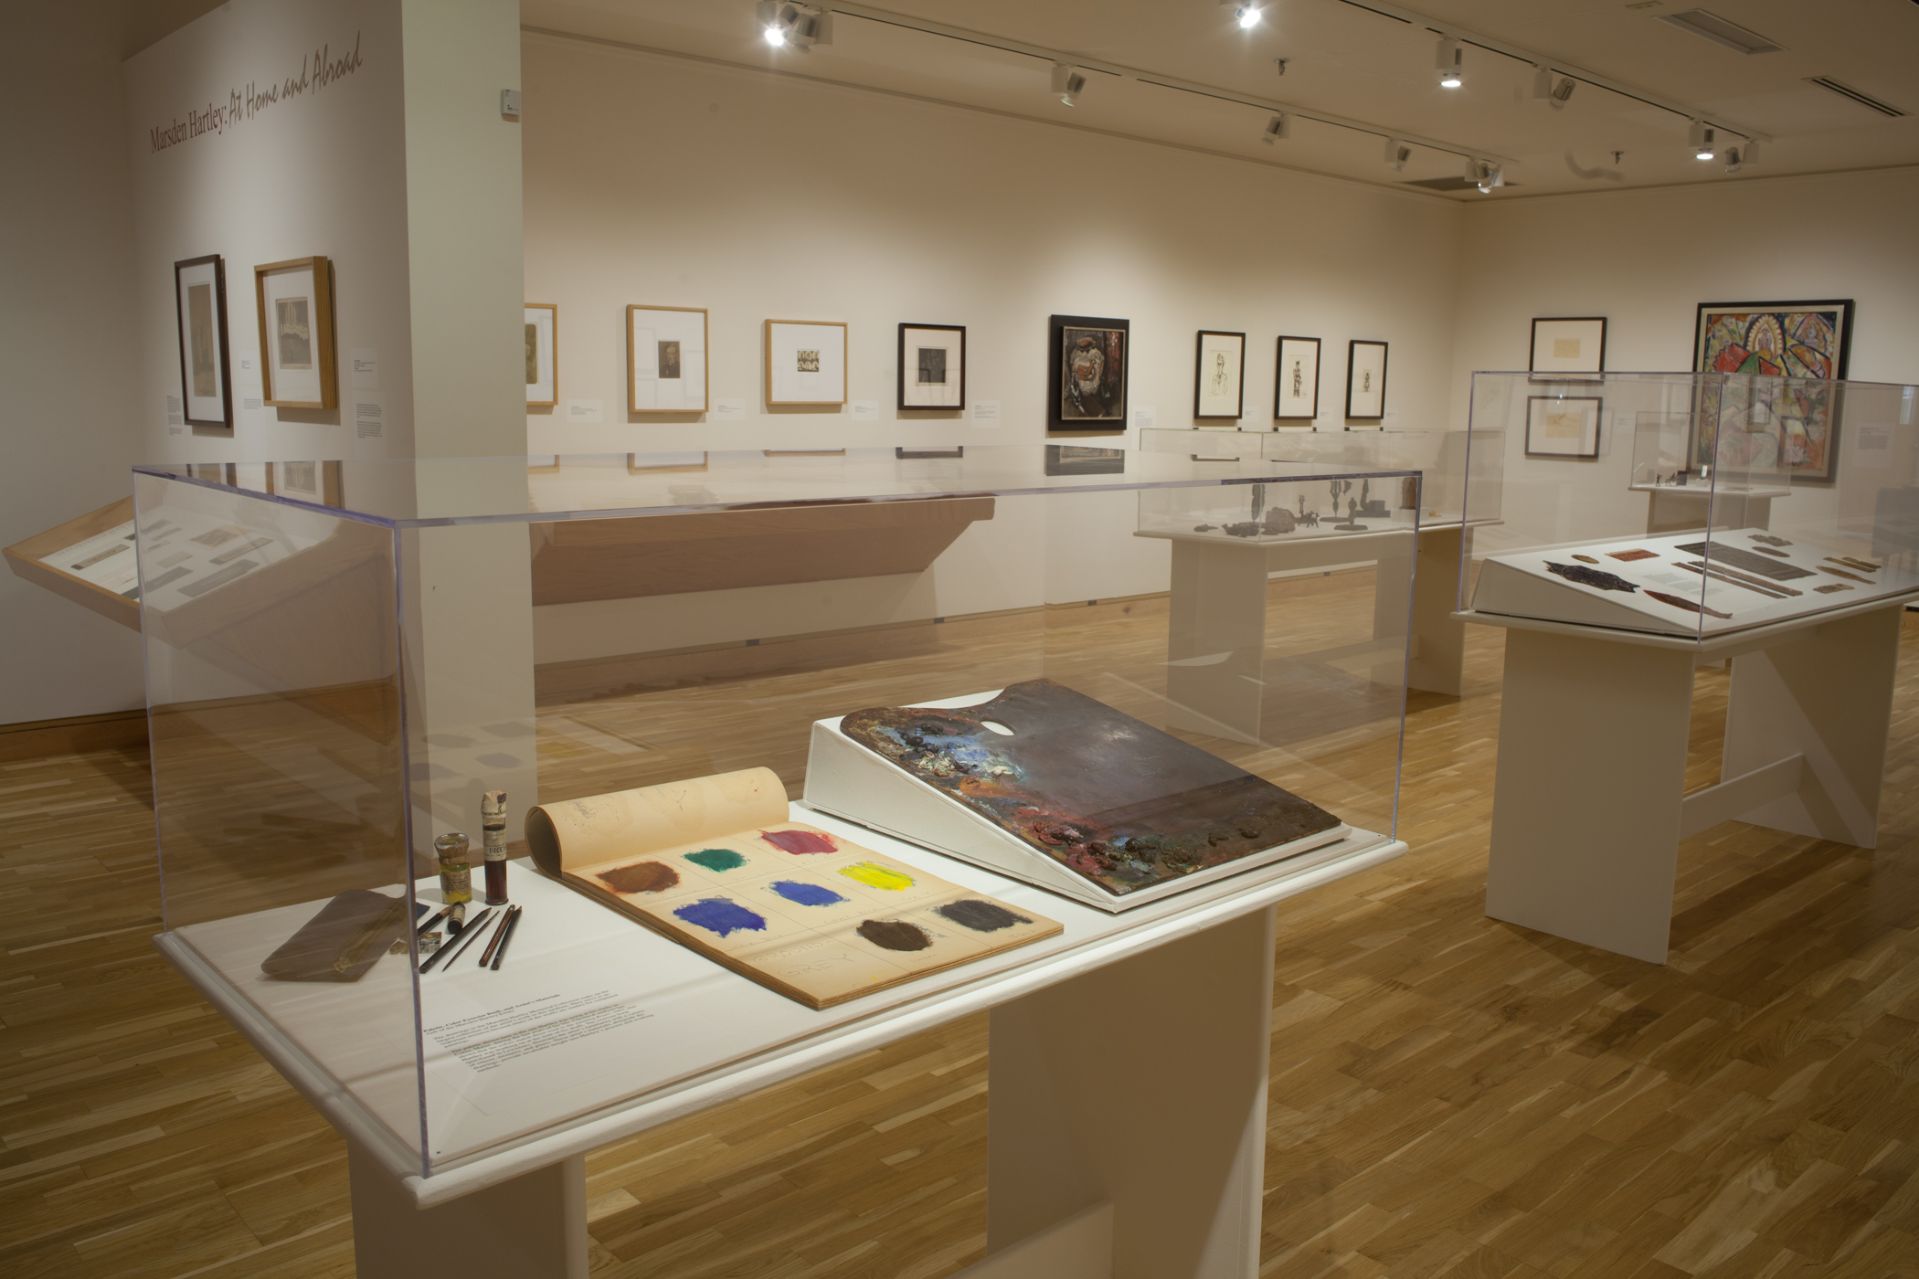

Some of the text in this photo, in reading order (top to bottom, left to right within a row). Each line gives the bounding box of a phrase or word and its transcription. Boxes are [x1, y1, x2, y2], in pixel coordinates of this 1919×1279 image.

[150, 29, 363, 154] Marsden Hartley: At Home and Abroad
